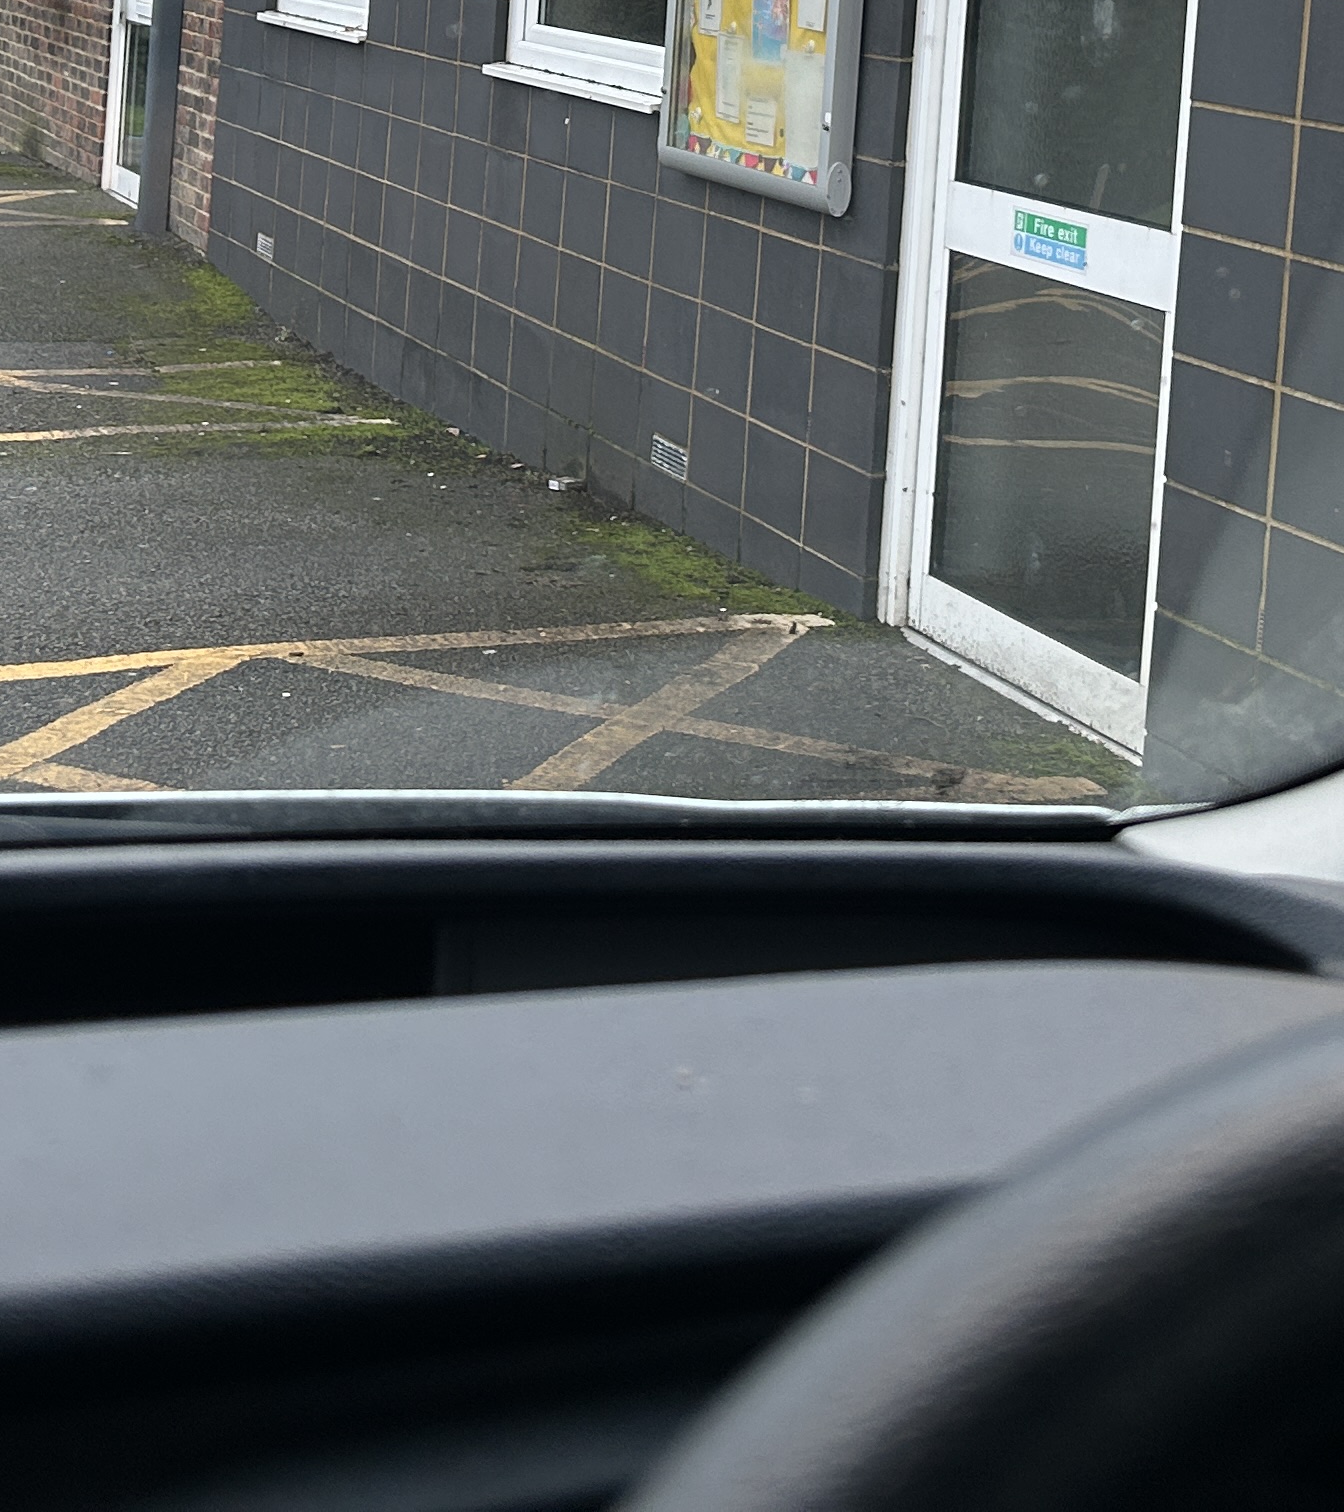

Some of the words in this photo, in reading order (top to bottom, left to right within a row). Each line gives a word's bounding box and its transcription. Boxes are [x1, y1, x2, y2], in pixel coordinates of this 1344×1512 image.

[1033, 217, 1054, 238] Fire
[1057, 226, 1078, 245] exit
[1029, 237, 1053, 259] Keep
[1055, 246, 1080, 264] clear
